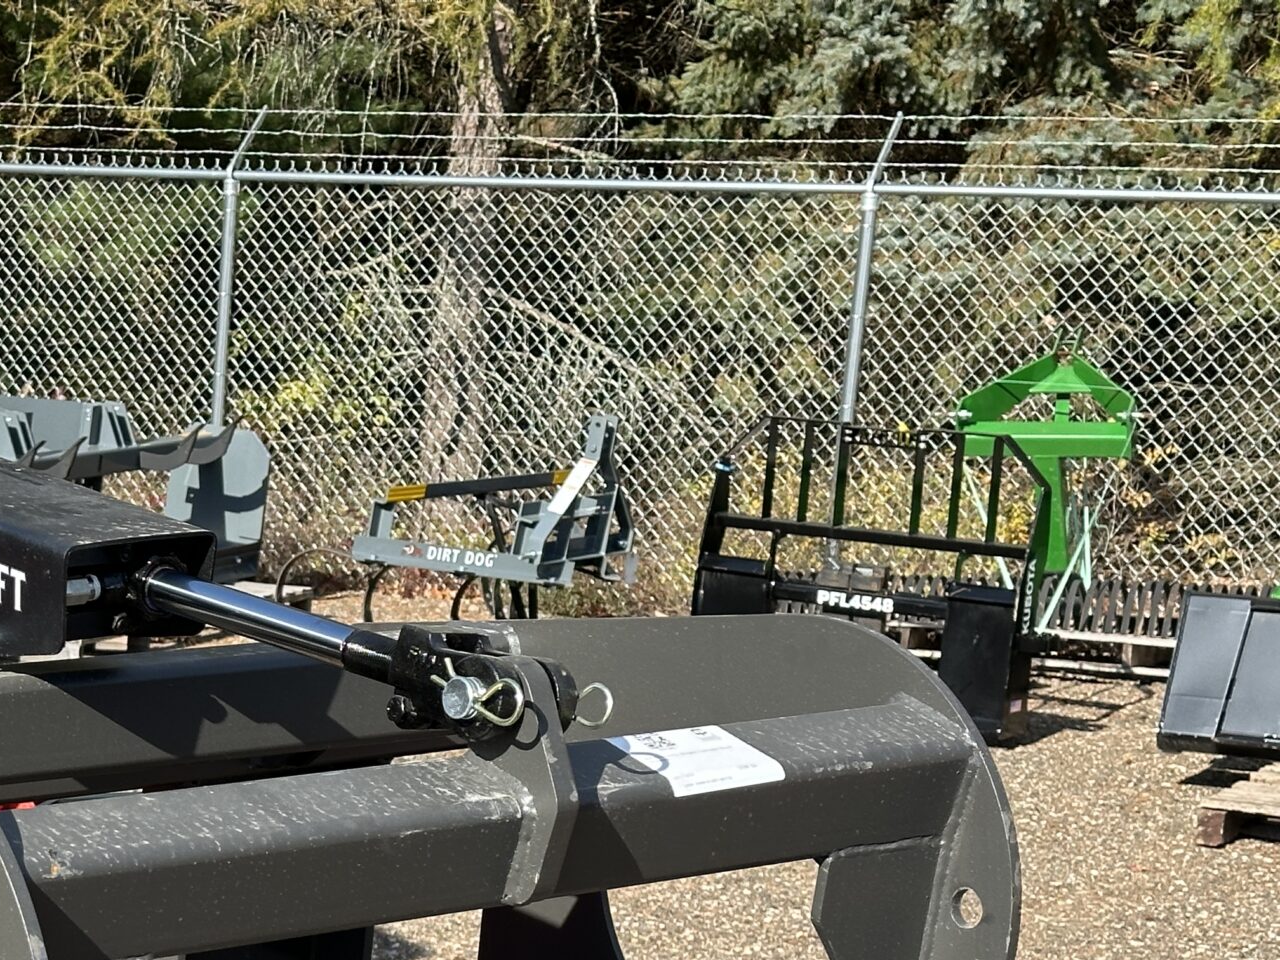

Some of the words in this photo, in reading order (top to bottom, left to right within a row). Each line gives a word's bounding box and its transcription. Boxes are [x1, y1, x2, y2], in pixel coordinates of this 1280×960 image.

[426, 546, 461, 563] DIRT
[464, 551, 494, 568] DOG
[816, 589, 894, 613] PFL4548
[1021, 559, 1037, 634] KUBOTA
